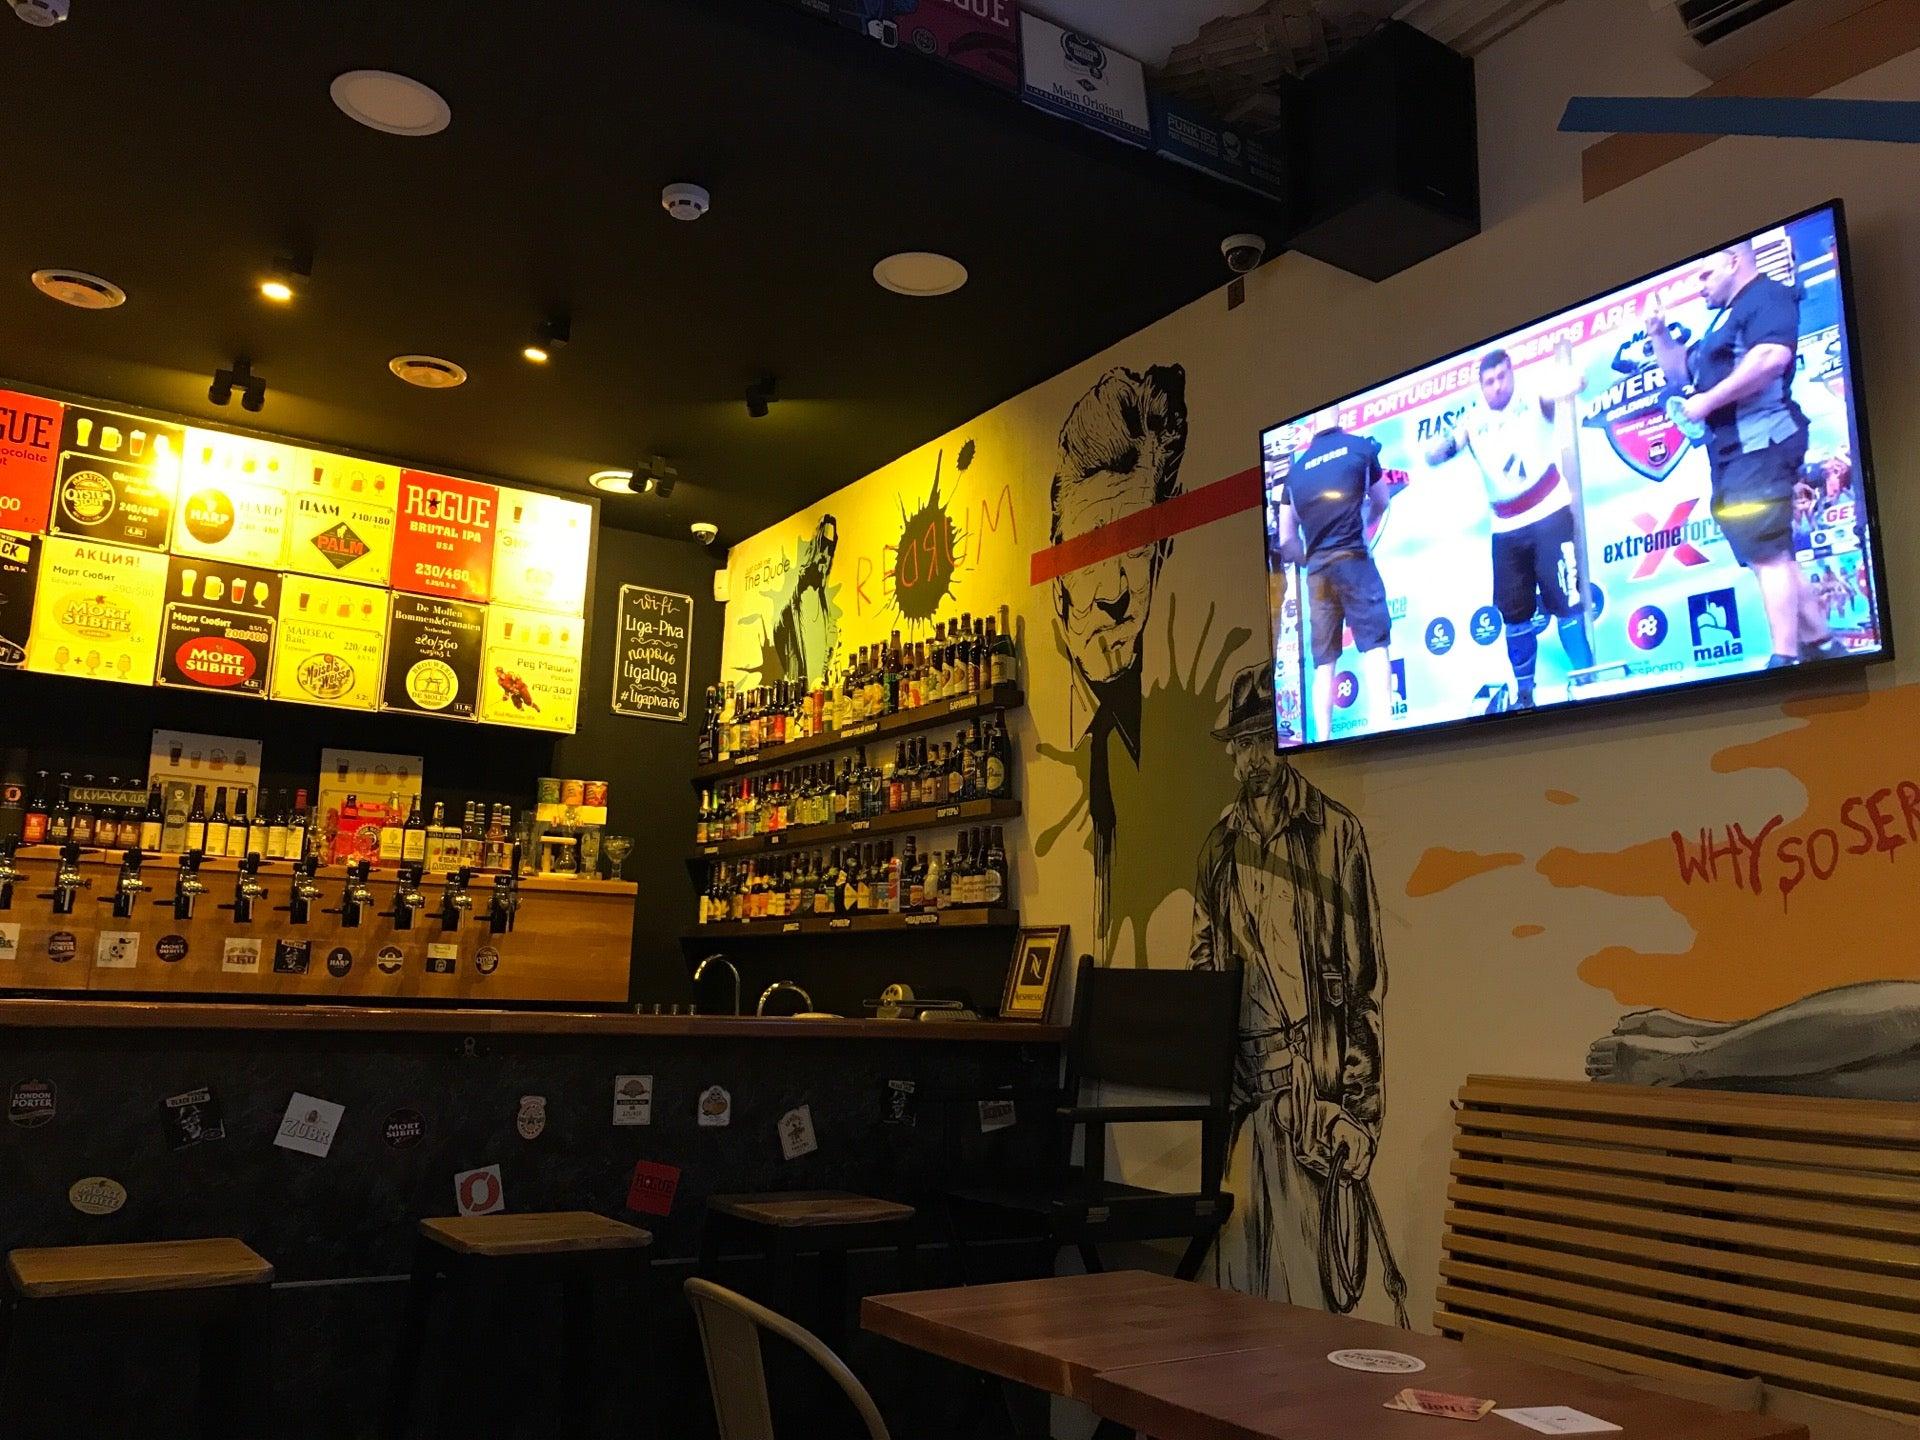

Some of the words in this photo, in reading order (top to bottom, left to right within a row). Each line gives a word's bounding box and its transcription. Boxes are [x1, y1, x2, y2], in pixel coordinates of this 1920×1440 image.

[1052, 82, 1080, 101] Mein
[1082, 94, 1124, 119] Original
[65, 488, 112, 502] OYSTER
[404, 484, 492, 529] ROGUE
[409, 520, 459, 539] BRUTAL
[462, 529, 483, 544] IPA
[317, 535, 364, 555] PALM
[436, 541, 455, 551] USA
[74, 547, 140, 567] АКЦИЯ!
[53, 565, 80, 577] Морт
[82, 569, 116, 581] Сюбит
[744, 573, 761, 592] The
[763, 559, 790, 583] Dude
[67, 600, 131, 620] MORT
[416, 602, 430, 613] De
[632, 593, 680, 616] wi-fi
[61, 612, 131, 633] SUBITE
[172, 611, 198, 623] Морт
[200, 615, 231, 627] Сюбит
[625, 613, 684, 639] Liga-Piva
[414, 634, 459, 650] 280/560
[189, 648, 245, 666] MORT
[627, 647, 676, 665] пароль
[185, 659, 246, 677] SUBITE
[73, 787, 127, 802] СКИДКА
[1671, 814, 1784, 896] WHY
[1776, 828, 1840, 915] SO
[330, 959, 350, 967] HARP
[12, 1099, 52, 1108] PORTER
[14, 1092, 51, 1100] LONDON
[281, 1118, 331, 1145] ZUBR
[385, 1128, 421, 1138] SUBITE
[387, 1121, 421, 1132] MORT
